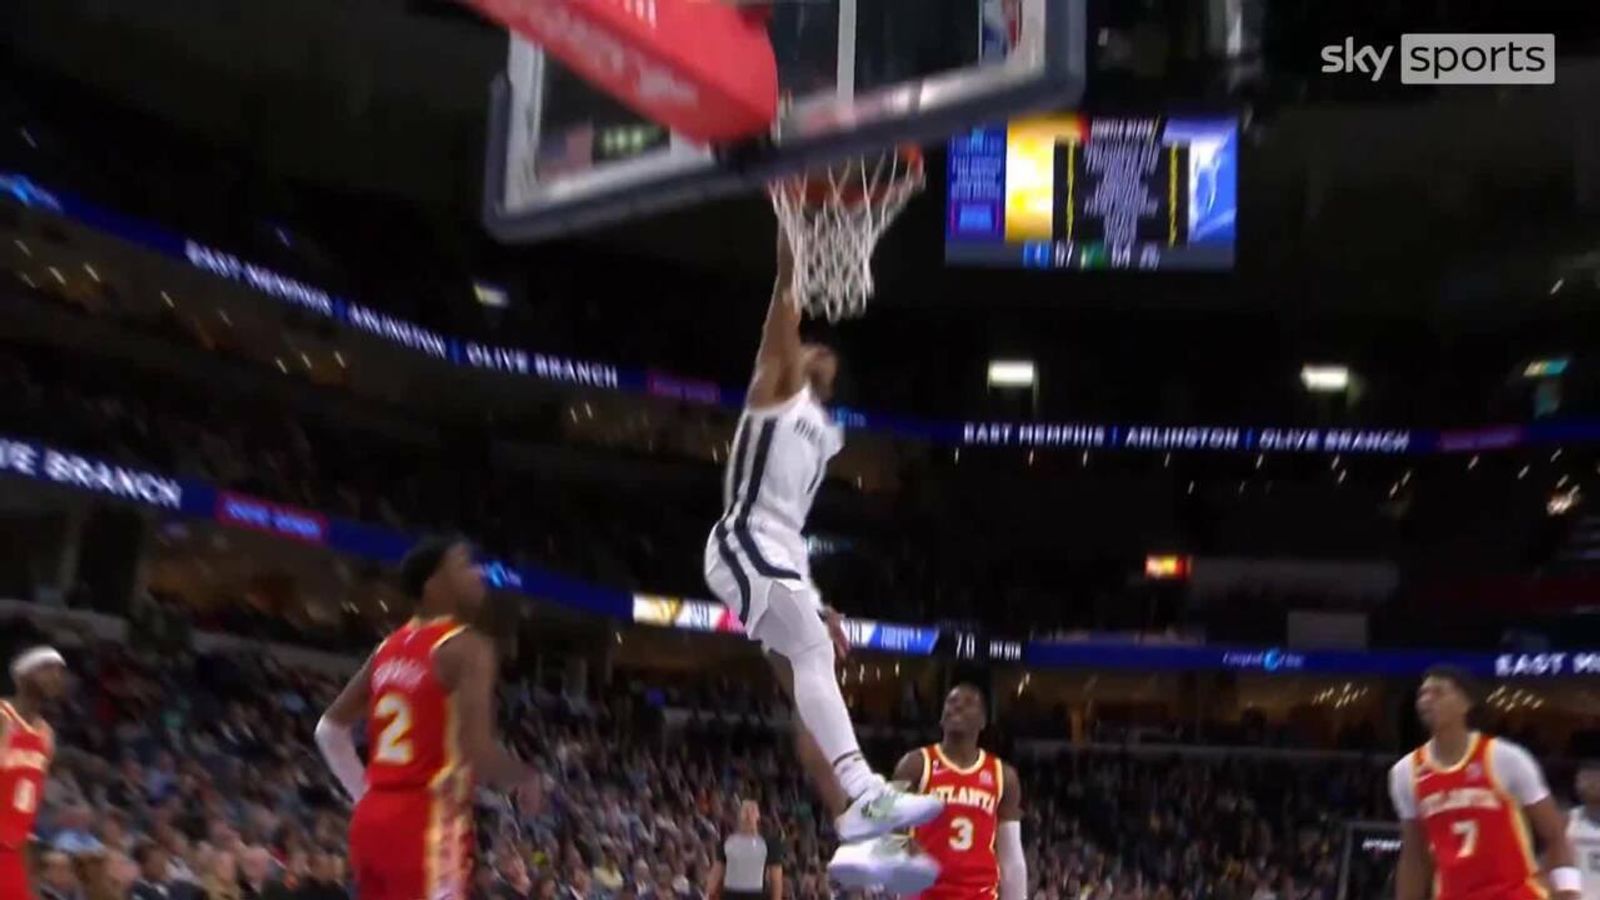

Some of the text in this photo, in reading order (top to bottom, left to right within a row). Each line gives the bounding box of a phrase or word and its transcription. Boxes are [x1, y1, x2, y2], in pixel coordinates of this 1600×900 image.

[465, 340, 529, 375] OLIVE
[534, 352, 618, 390] BRANCH
[44, 449, 183, 511] BRANCH
[1495, 652, 1567, 677] EAST
[374, 692, 413, 764] 2
[949, 816, 974, 851] 3
[1450, 819, 1479, 858] 7
